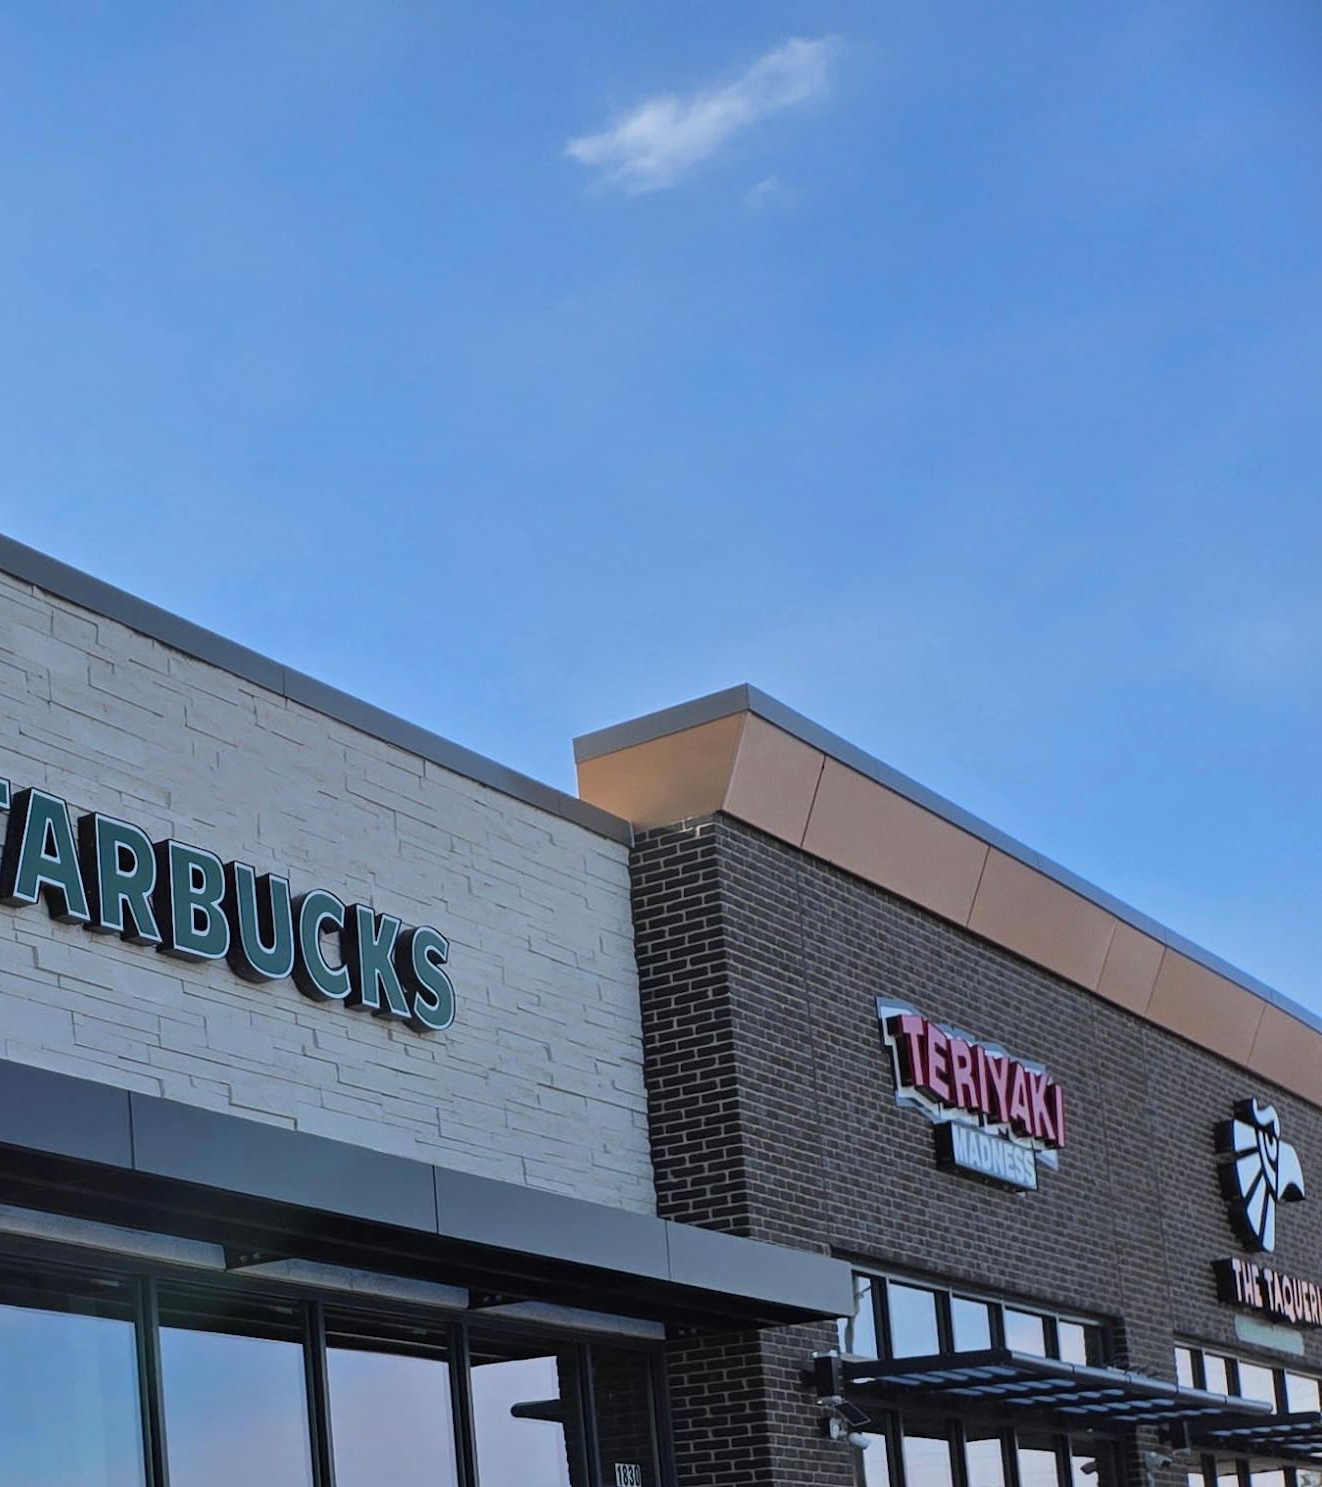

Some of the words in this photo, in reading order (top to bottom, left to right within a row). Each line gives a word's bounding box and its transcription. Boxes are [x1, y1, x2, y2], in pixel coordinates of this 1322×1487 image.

[895, 1013, 1067, 1149] TERIYAKI
[957, 1124, 1036, 1186] MADNESS
[1231, 1258, 1264, 1308] THE
[617, 1464, 641, 1487] 1830
